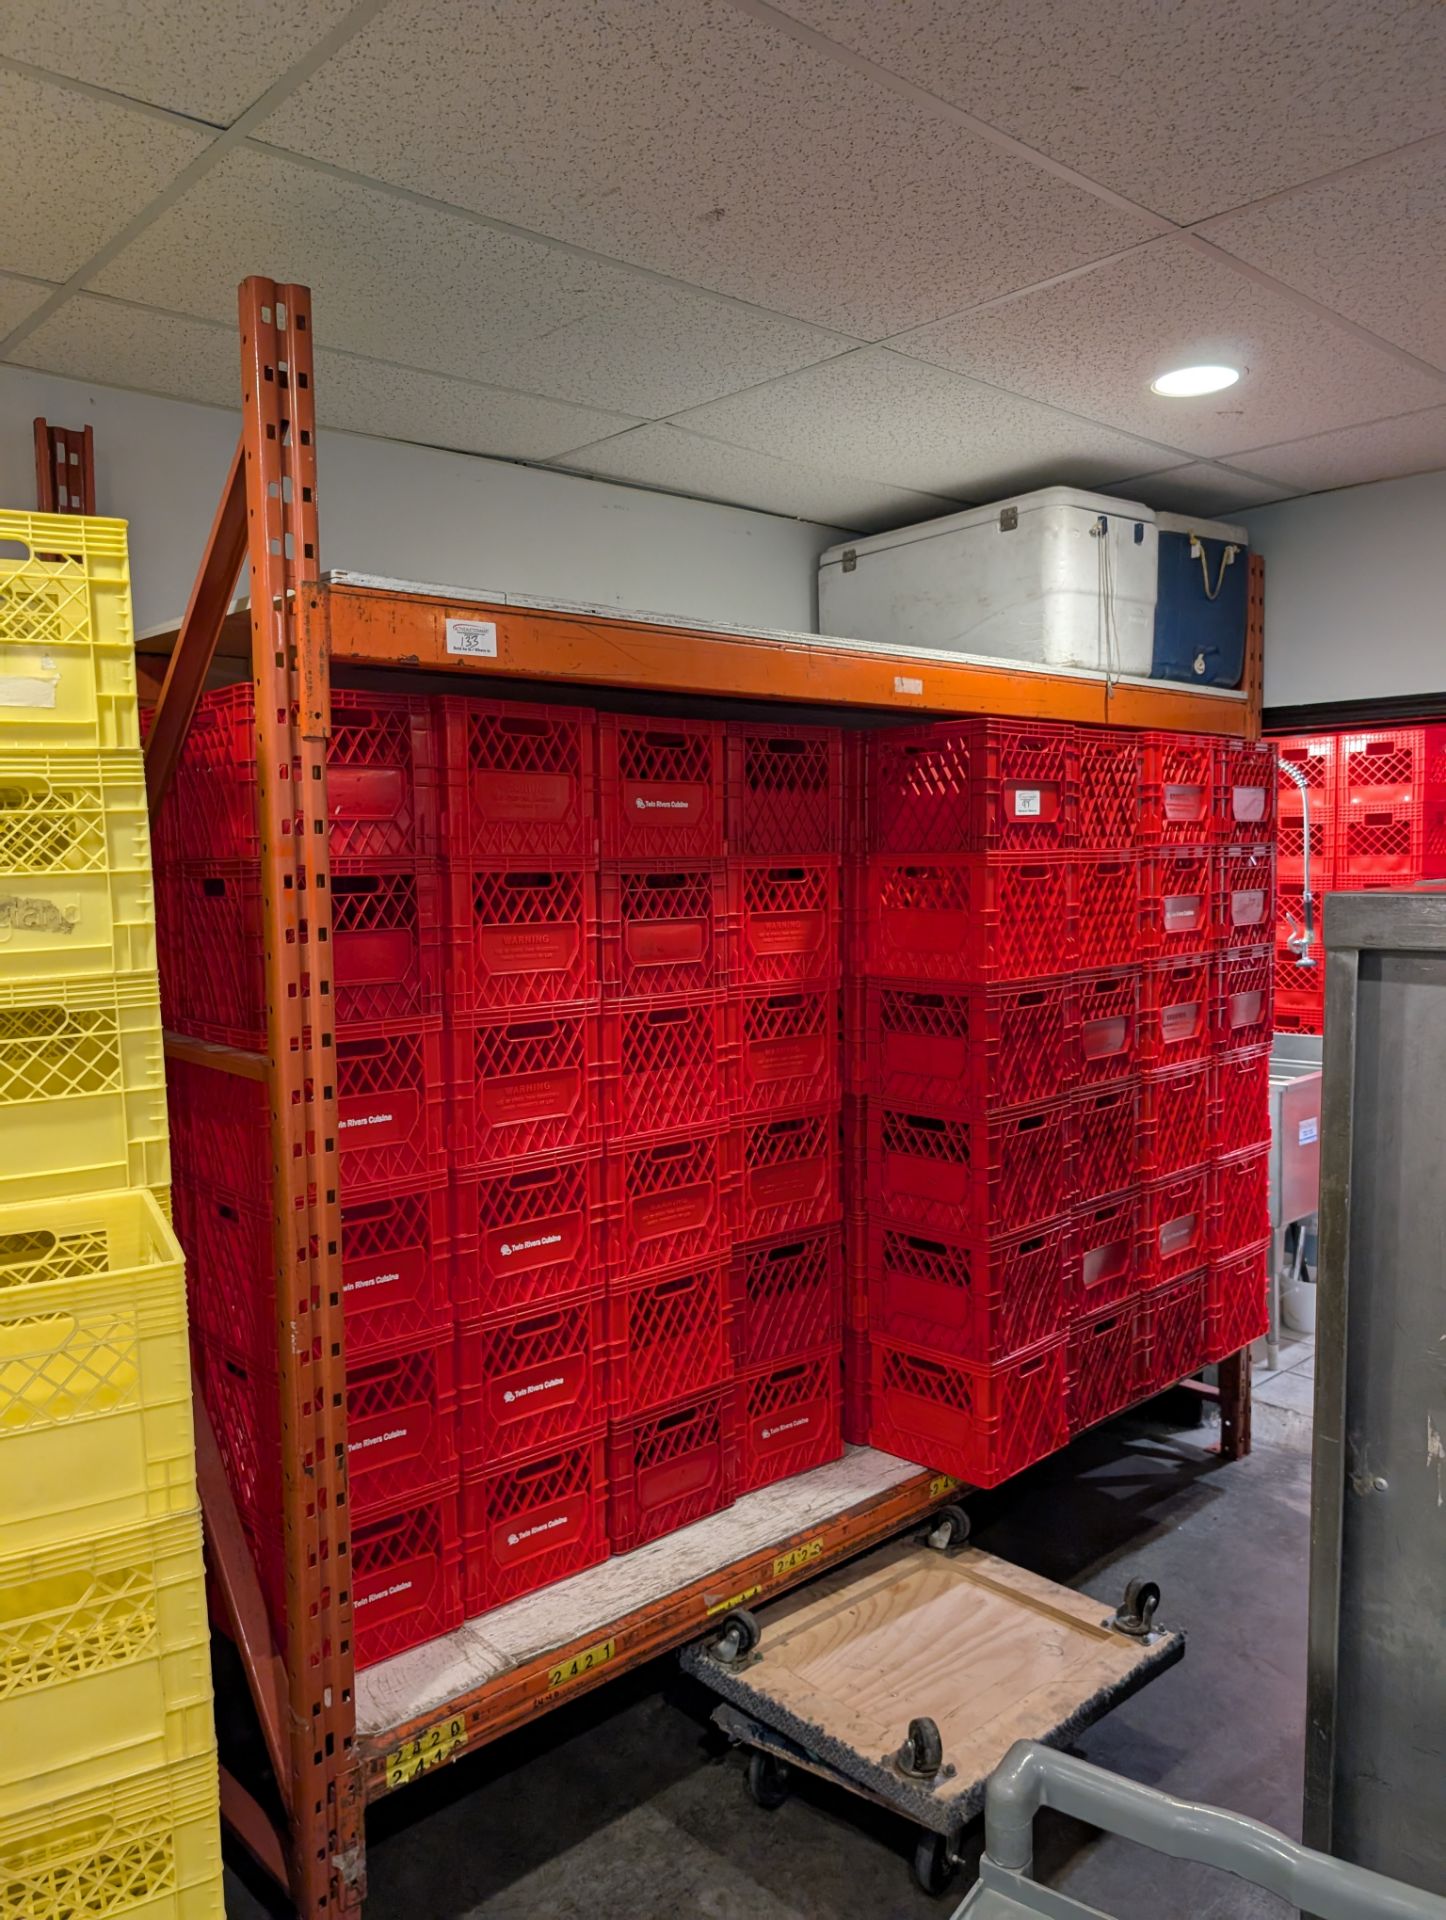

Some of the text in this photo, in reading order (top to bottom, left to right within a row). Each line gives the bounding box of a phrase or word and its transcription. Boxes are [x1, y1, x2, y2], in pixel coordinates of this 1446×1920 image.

[461, 635, 479, 649] 133
[656, 800, 670, 808] Rivers
[670, 800, 689, 808] Cuisine
[347, 1118, 368, 1128] Rivers
[368, 1114, 393, 1124] Cuisine
[524, 1239, 541, 1249] Rivers
[541, 1235, 561, 1245] Cuisine
[343, 1273, 399, 1292] win Rivers Cuisine
[527, 1383, 544, 1394] Rivers
[544, 1377, 564, 1389] Cuisine
[780, 1422, 793, 1431] Rivers
[793, 1417, 809, 1426] Cuisine
[362, 1435, 383, 1448] Rivers
[383, 1429, 407, 1441] Cuisine
[531, 1523, 548, 1535] Rivers
[548, 1516, 568, 1528] Cuisine
[368, 1590, 389, 1603] Rivers
[388, 1581, 412, 1594] Cuisine
[553, 1643, 610, 1685] 2421
